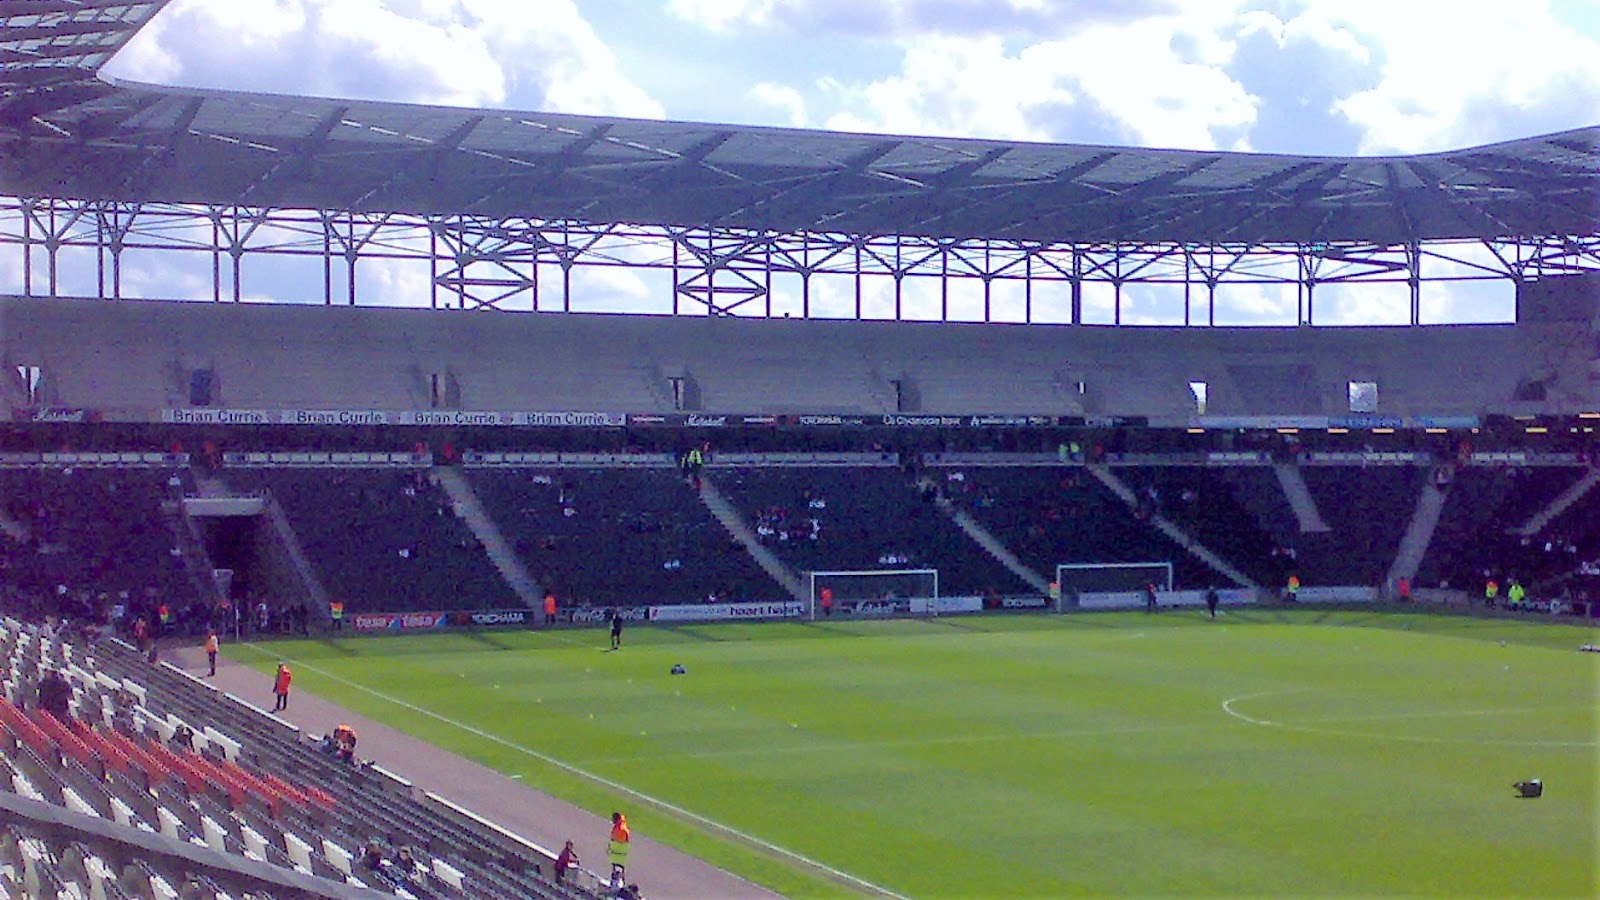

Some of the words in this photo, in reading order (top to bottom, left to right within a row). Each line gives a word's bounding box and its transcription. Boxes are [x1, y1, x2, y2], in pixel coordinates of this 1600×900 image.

[172, 409, 213, 422] Brian
[218, 410, 262, 423] Currie
[296, 411, 334, 423] Brian
[339, 411, 383, 423] Currie
[414, 411, 450, 423] Brian
[455, 412, 496, 424] Currie
[526, 412, 561, 425] Brian
[565, 412, 605, 425] Currie
